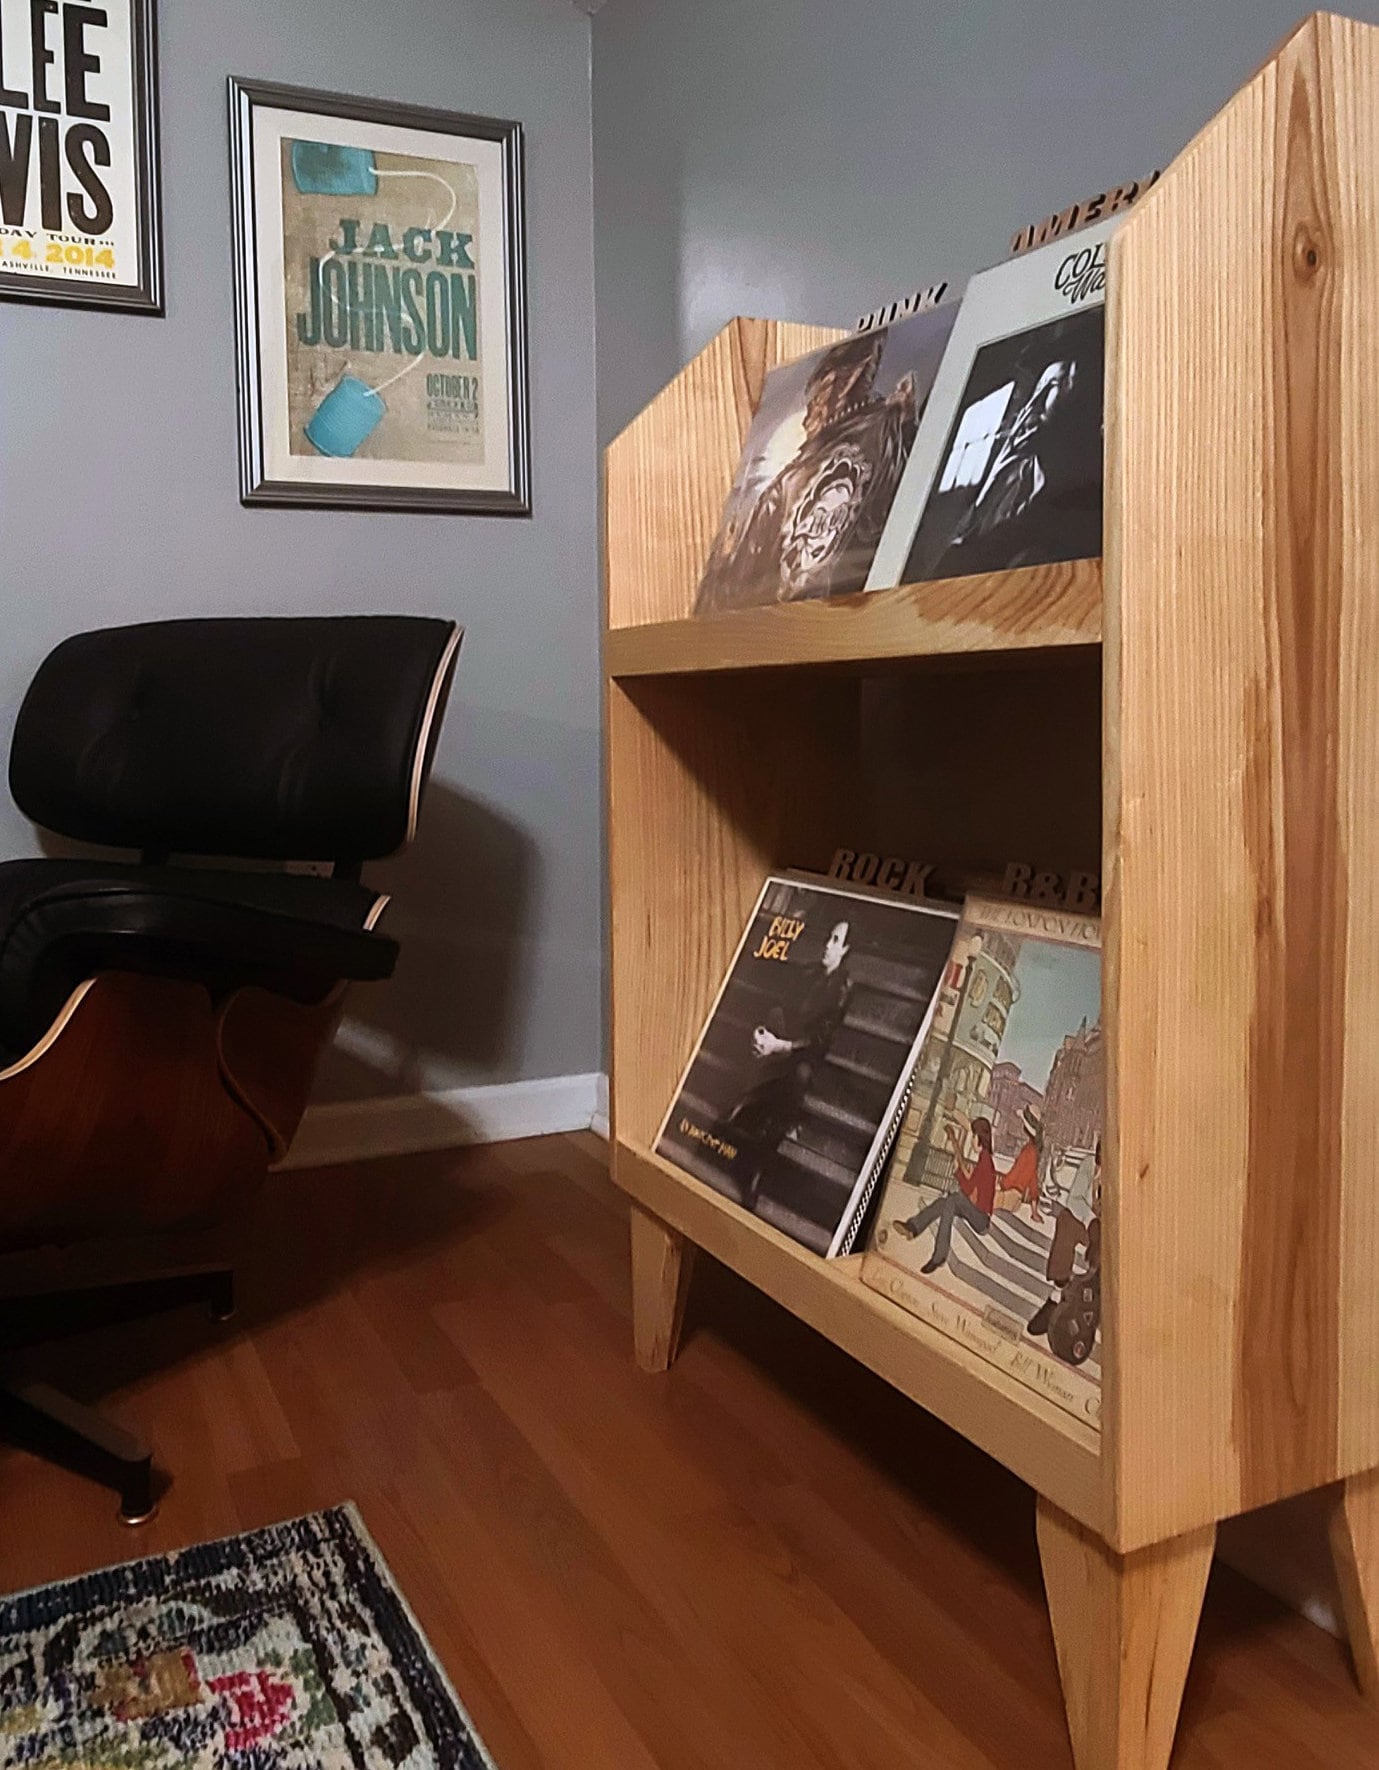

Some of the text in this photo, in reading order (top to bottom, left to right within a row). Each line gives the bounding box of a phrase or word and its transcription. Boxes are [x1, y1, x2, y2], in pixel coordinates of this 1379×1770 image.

[46, 243, 115, 269] 2014
[329, 218, 475, 270] JACK
[63, 266, 116, 279] TENNESSEE
[296, 255, 478, 361] JOHNSON
[426, 372, 479, 401] OCTOBER 2
[827, 847, 937, 897] ROCK
[1003, 862, 1099, 914] R&B
[768, 915, 805, 941] BILLY
[753, 935, 790, 961] JOEL
